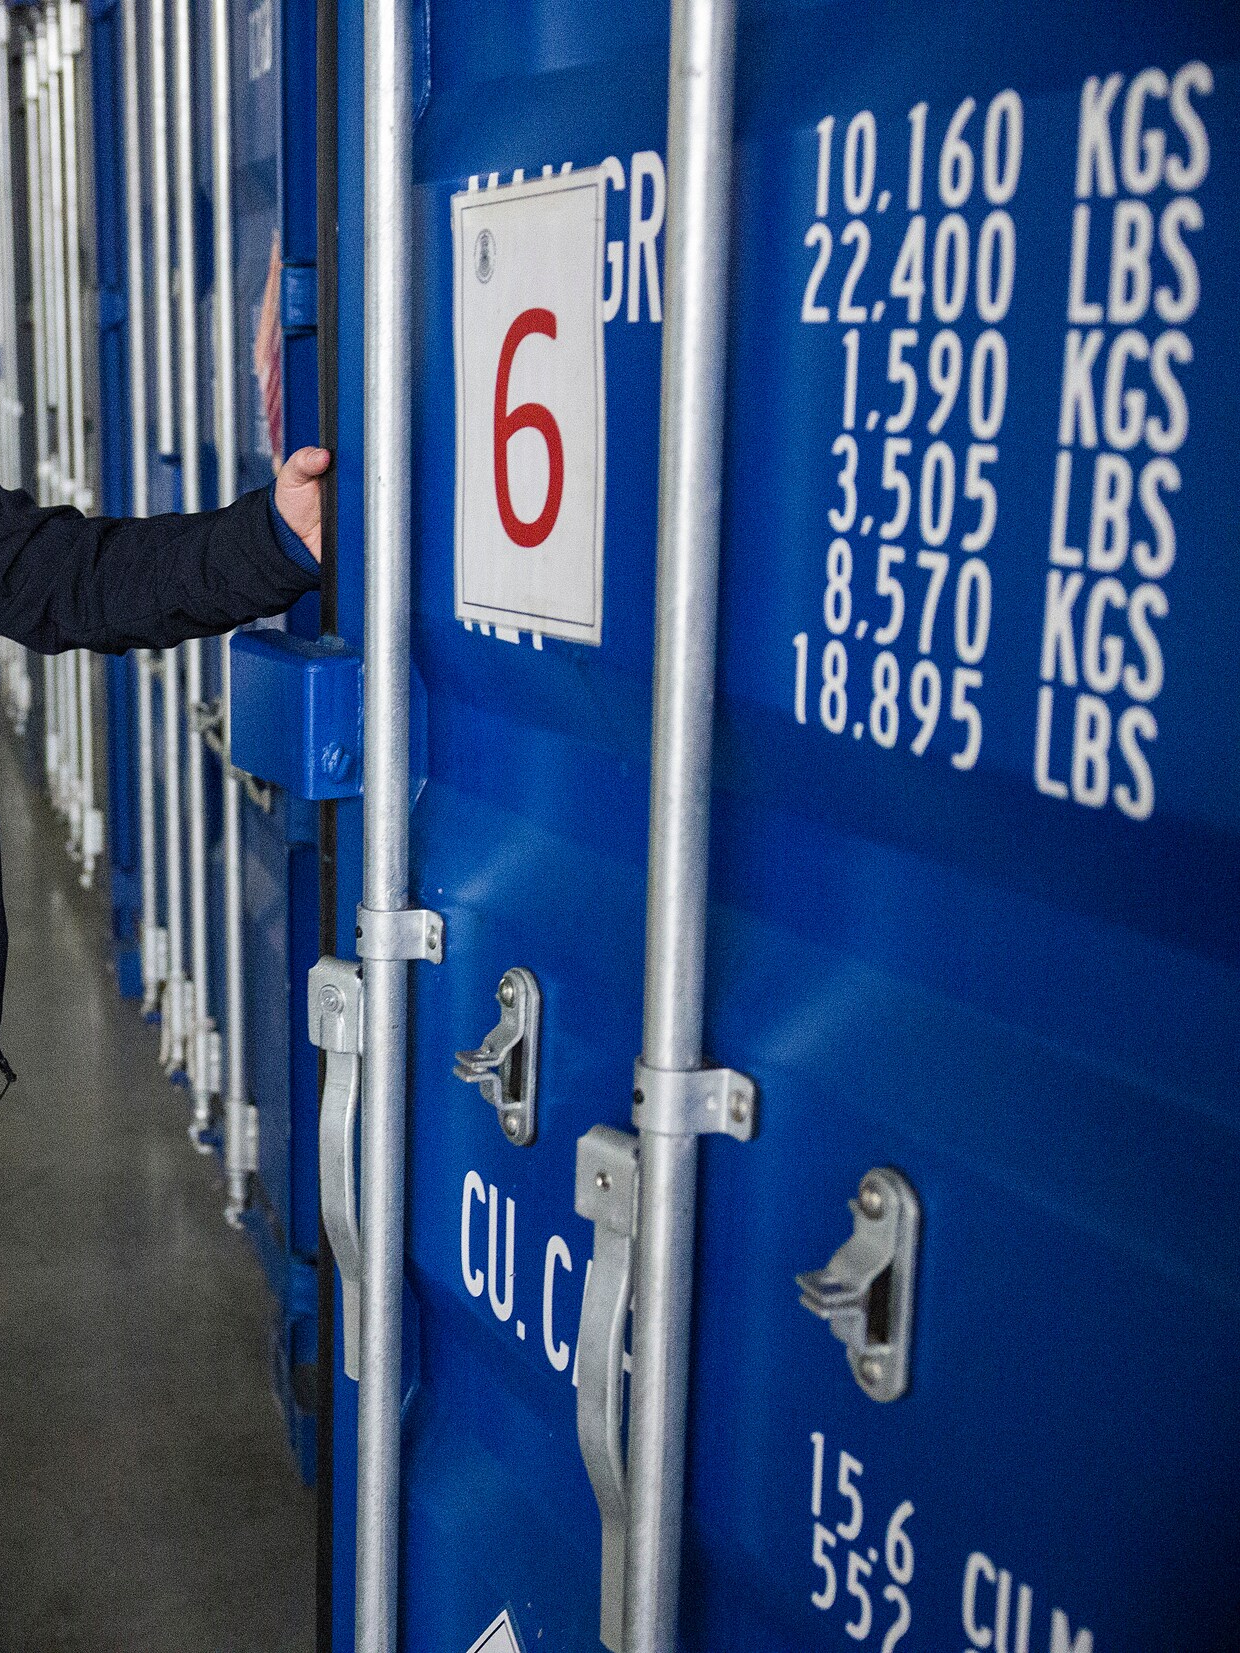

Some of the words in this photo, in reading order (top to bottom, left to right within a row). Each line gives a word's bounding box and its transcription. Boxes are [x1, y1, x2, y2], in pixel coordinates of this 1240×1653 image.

[814, 89, 1024, 220] 10,160
[1075, 61, 1214, 199] KGS
[800, 209, 1016, 324] 22,400
[1066, 197, 1204, 324] LBS
[494, 308, 564, 548] 6
[841, 328, 1009, 441] 1,590
[1057, 329, 1193, 454] KGS
[827, 433, 999, 553] 3,505
[1049, 450, 1182, 579] LBS
[1039, 569, 1169, 703] KGS
[1033, 684, 1159, 821] LBS
